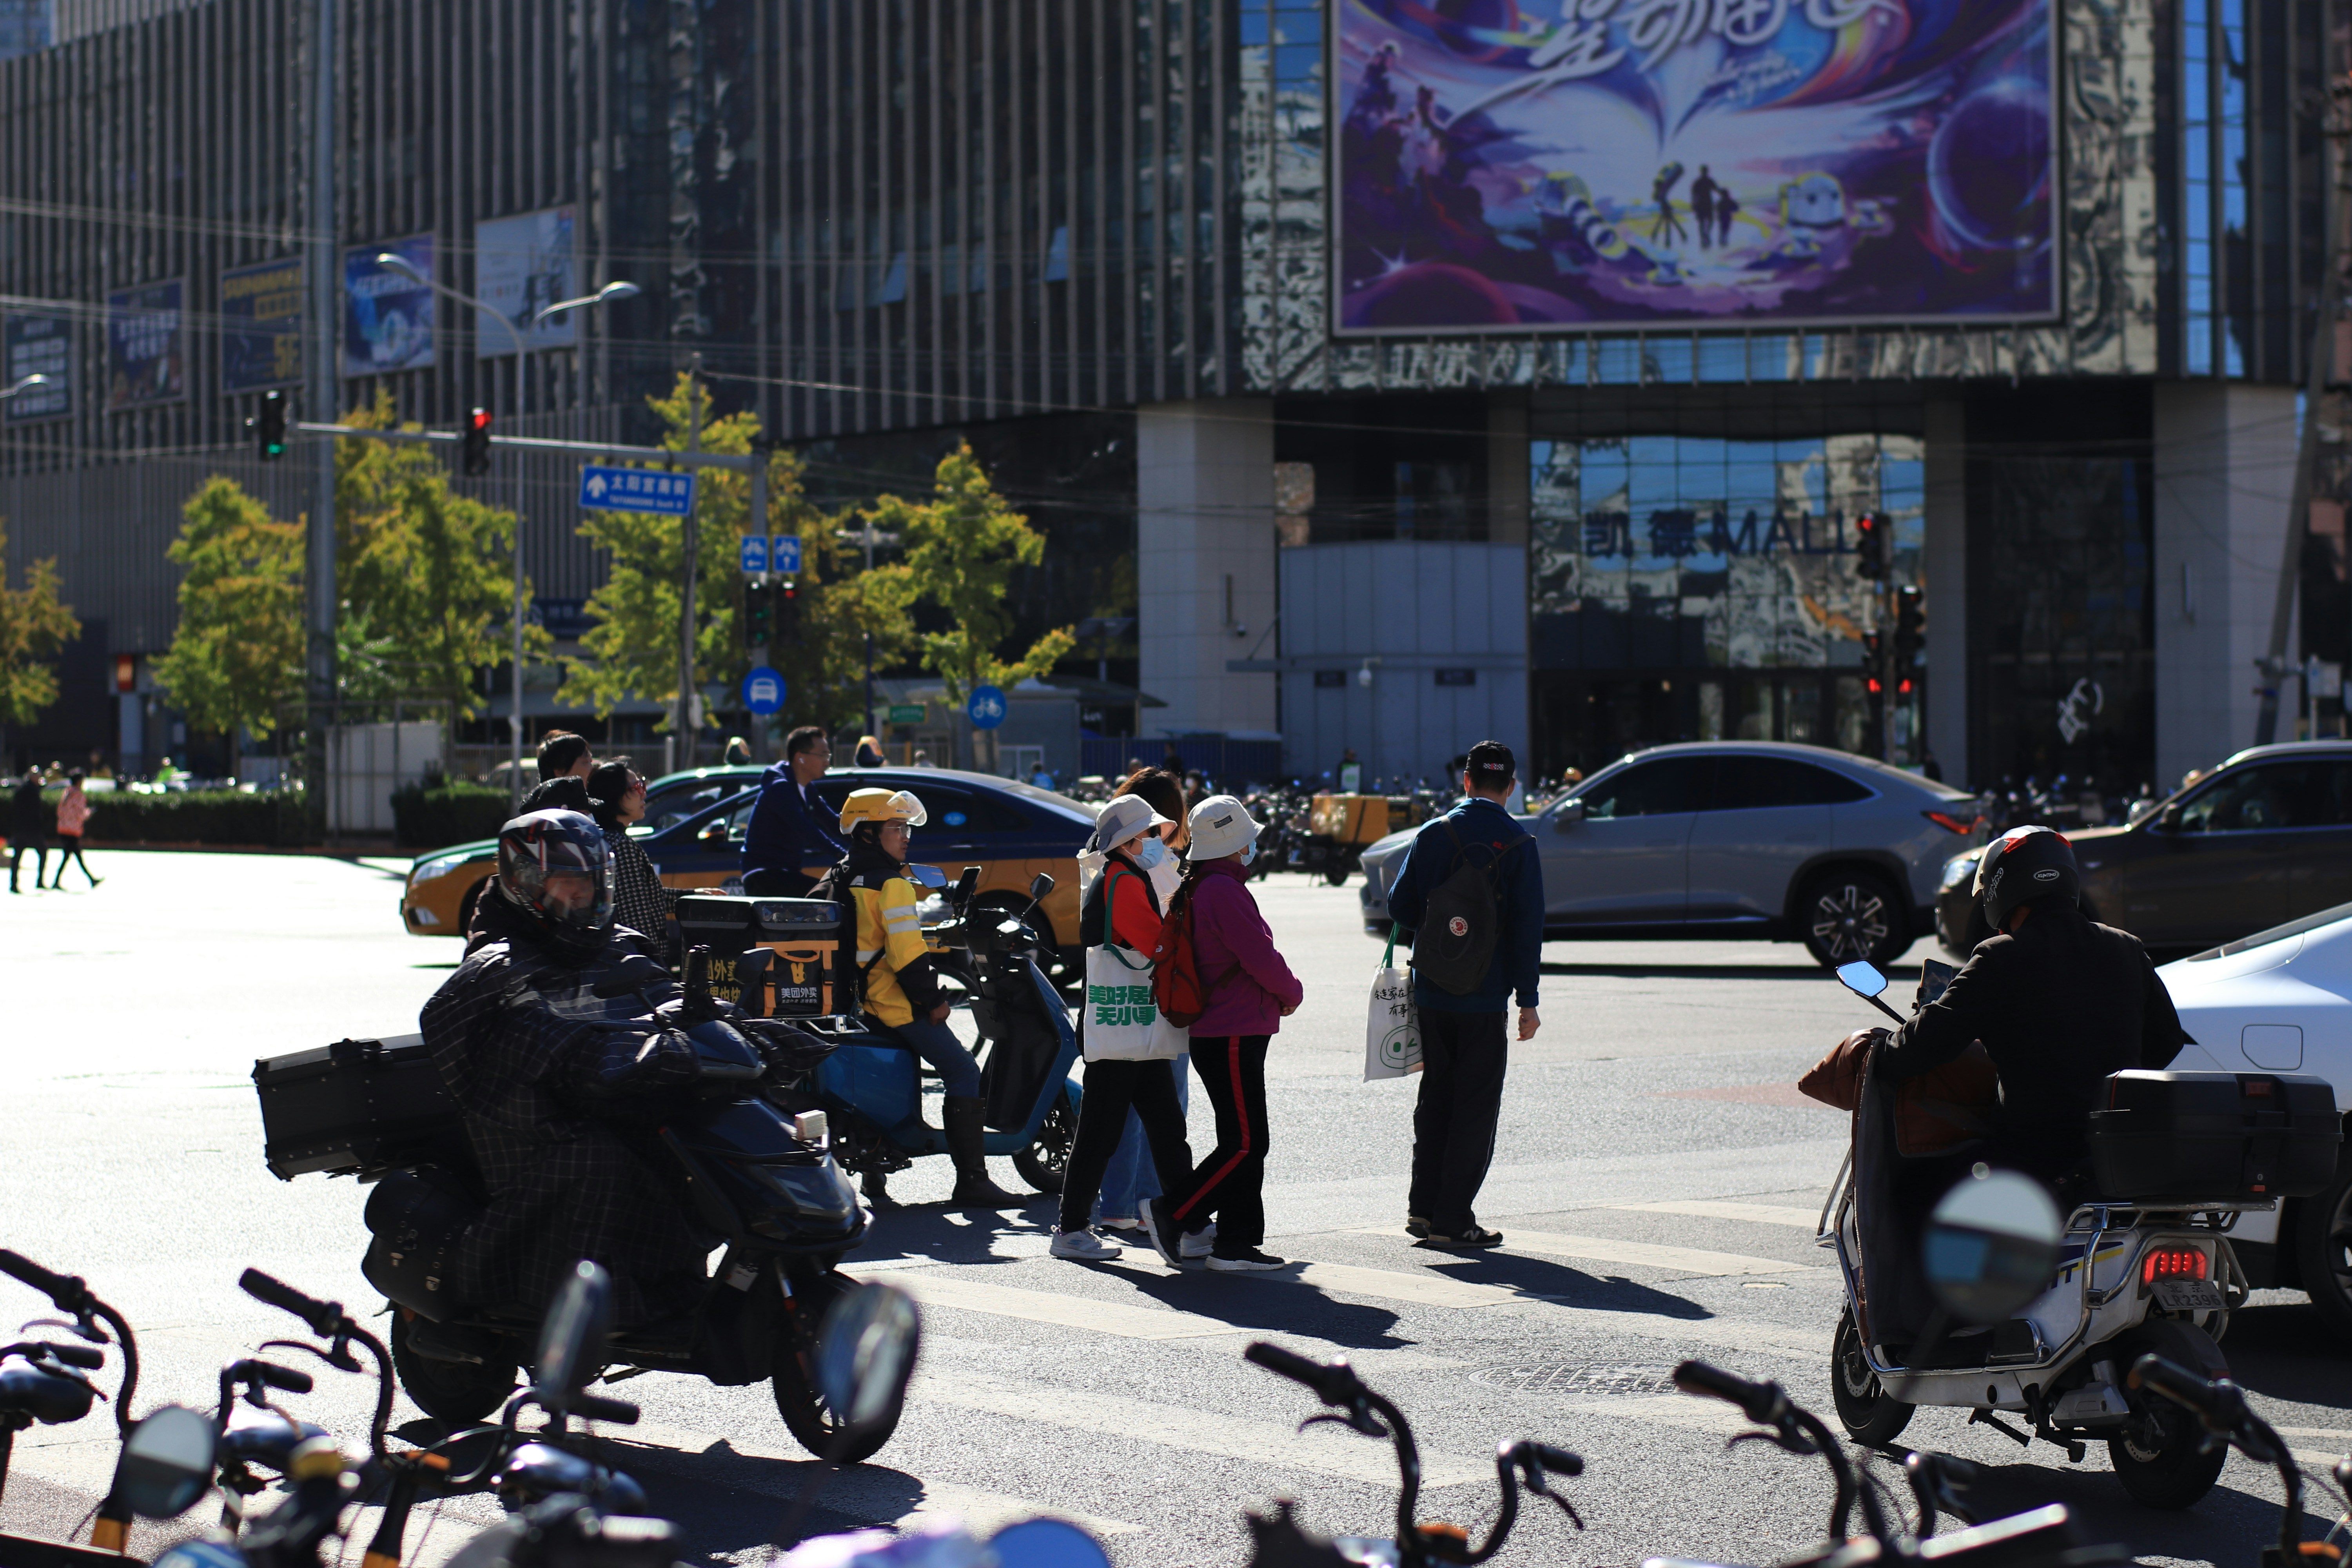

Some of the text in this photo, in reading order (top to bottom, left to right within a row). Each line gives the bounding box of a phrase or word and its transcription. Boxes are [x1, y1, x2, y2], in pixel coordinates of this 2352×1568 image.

[781, 987, 817, 998] 美团外卖
[1095, 1005, 1157, 1026] 无小事
[2168, 1282, 2203, 1294] 北京
[2161, 1294, 2222, 1307] LR2396
